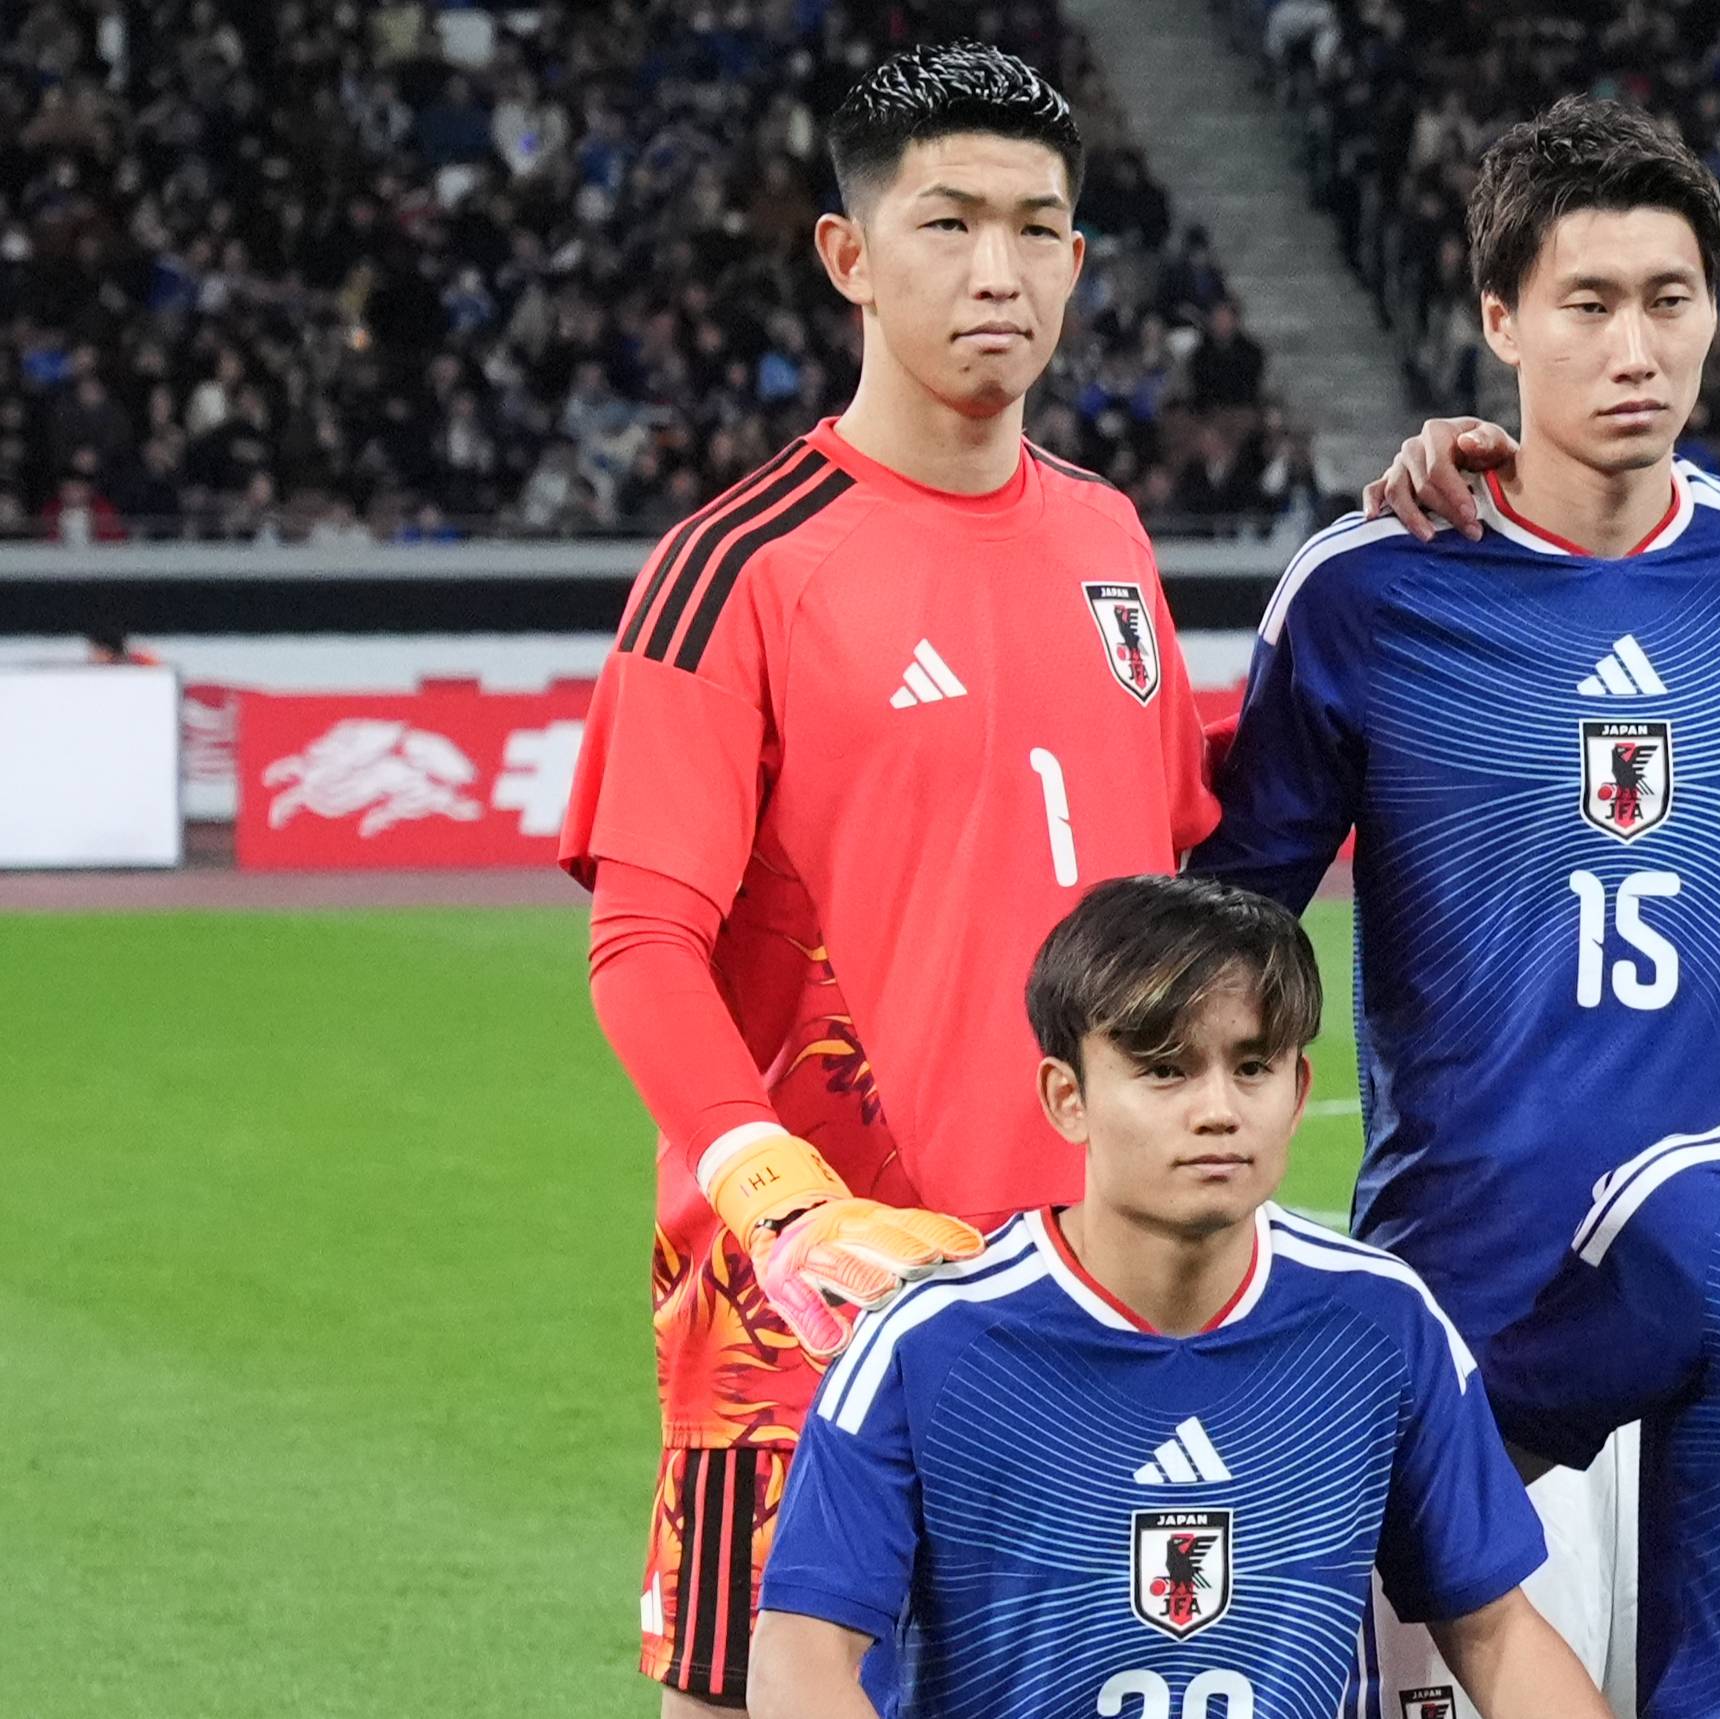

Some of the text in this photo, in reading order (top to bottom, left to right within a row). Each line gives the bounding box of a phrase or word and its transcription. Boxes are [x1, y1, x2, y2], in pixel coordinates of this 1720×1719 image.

[1101, 587, 1129, 598] JAPAN
[1602, 725, 1648, 736] JAPAN
[1030, 747, 1078, 887] 1
[1605, 802, 1644, 820] JFA
[1569, 870, 1681, 1010] 15
[1157, 1515, 1208, 1526] JAPAN
[1160, 1598, 1202, 1616] JFA
[1412, 1689, 1443, 1700] JAPAN
